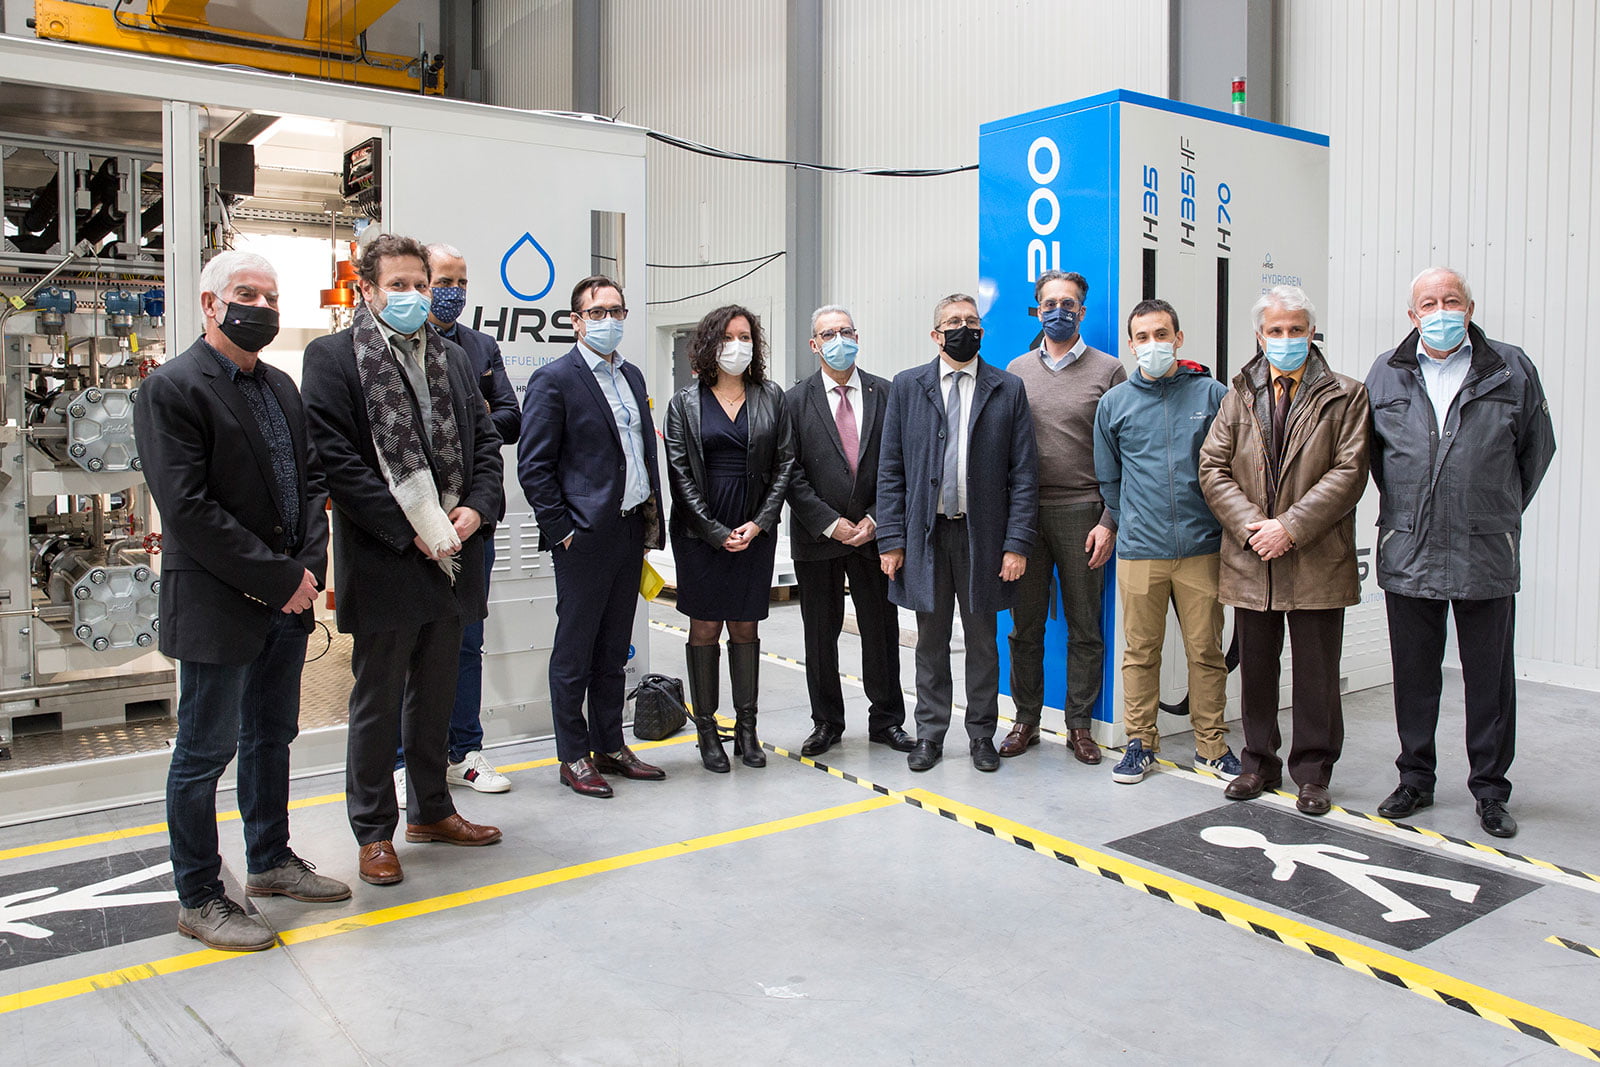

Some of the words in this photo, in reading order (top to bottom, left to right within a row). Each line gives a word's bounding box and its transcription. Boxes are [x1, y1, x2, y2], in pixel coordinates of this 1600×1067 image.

[1027, 136, 1060, 283] 200
[1142, 164, 1159, 242] H35
[1217, 182, 1231, 252] H70
[1262, 273, 1302, 287] HYDROGEN
[473, 306, 577, 343] HRS
[502, 355, 555, 366] EFUELING
